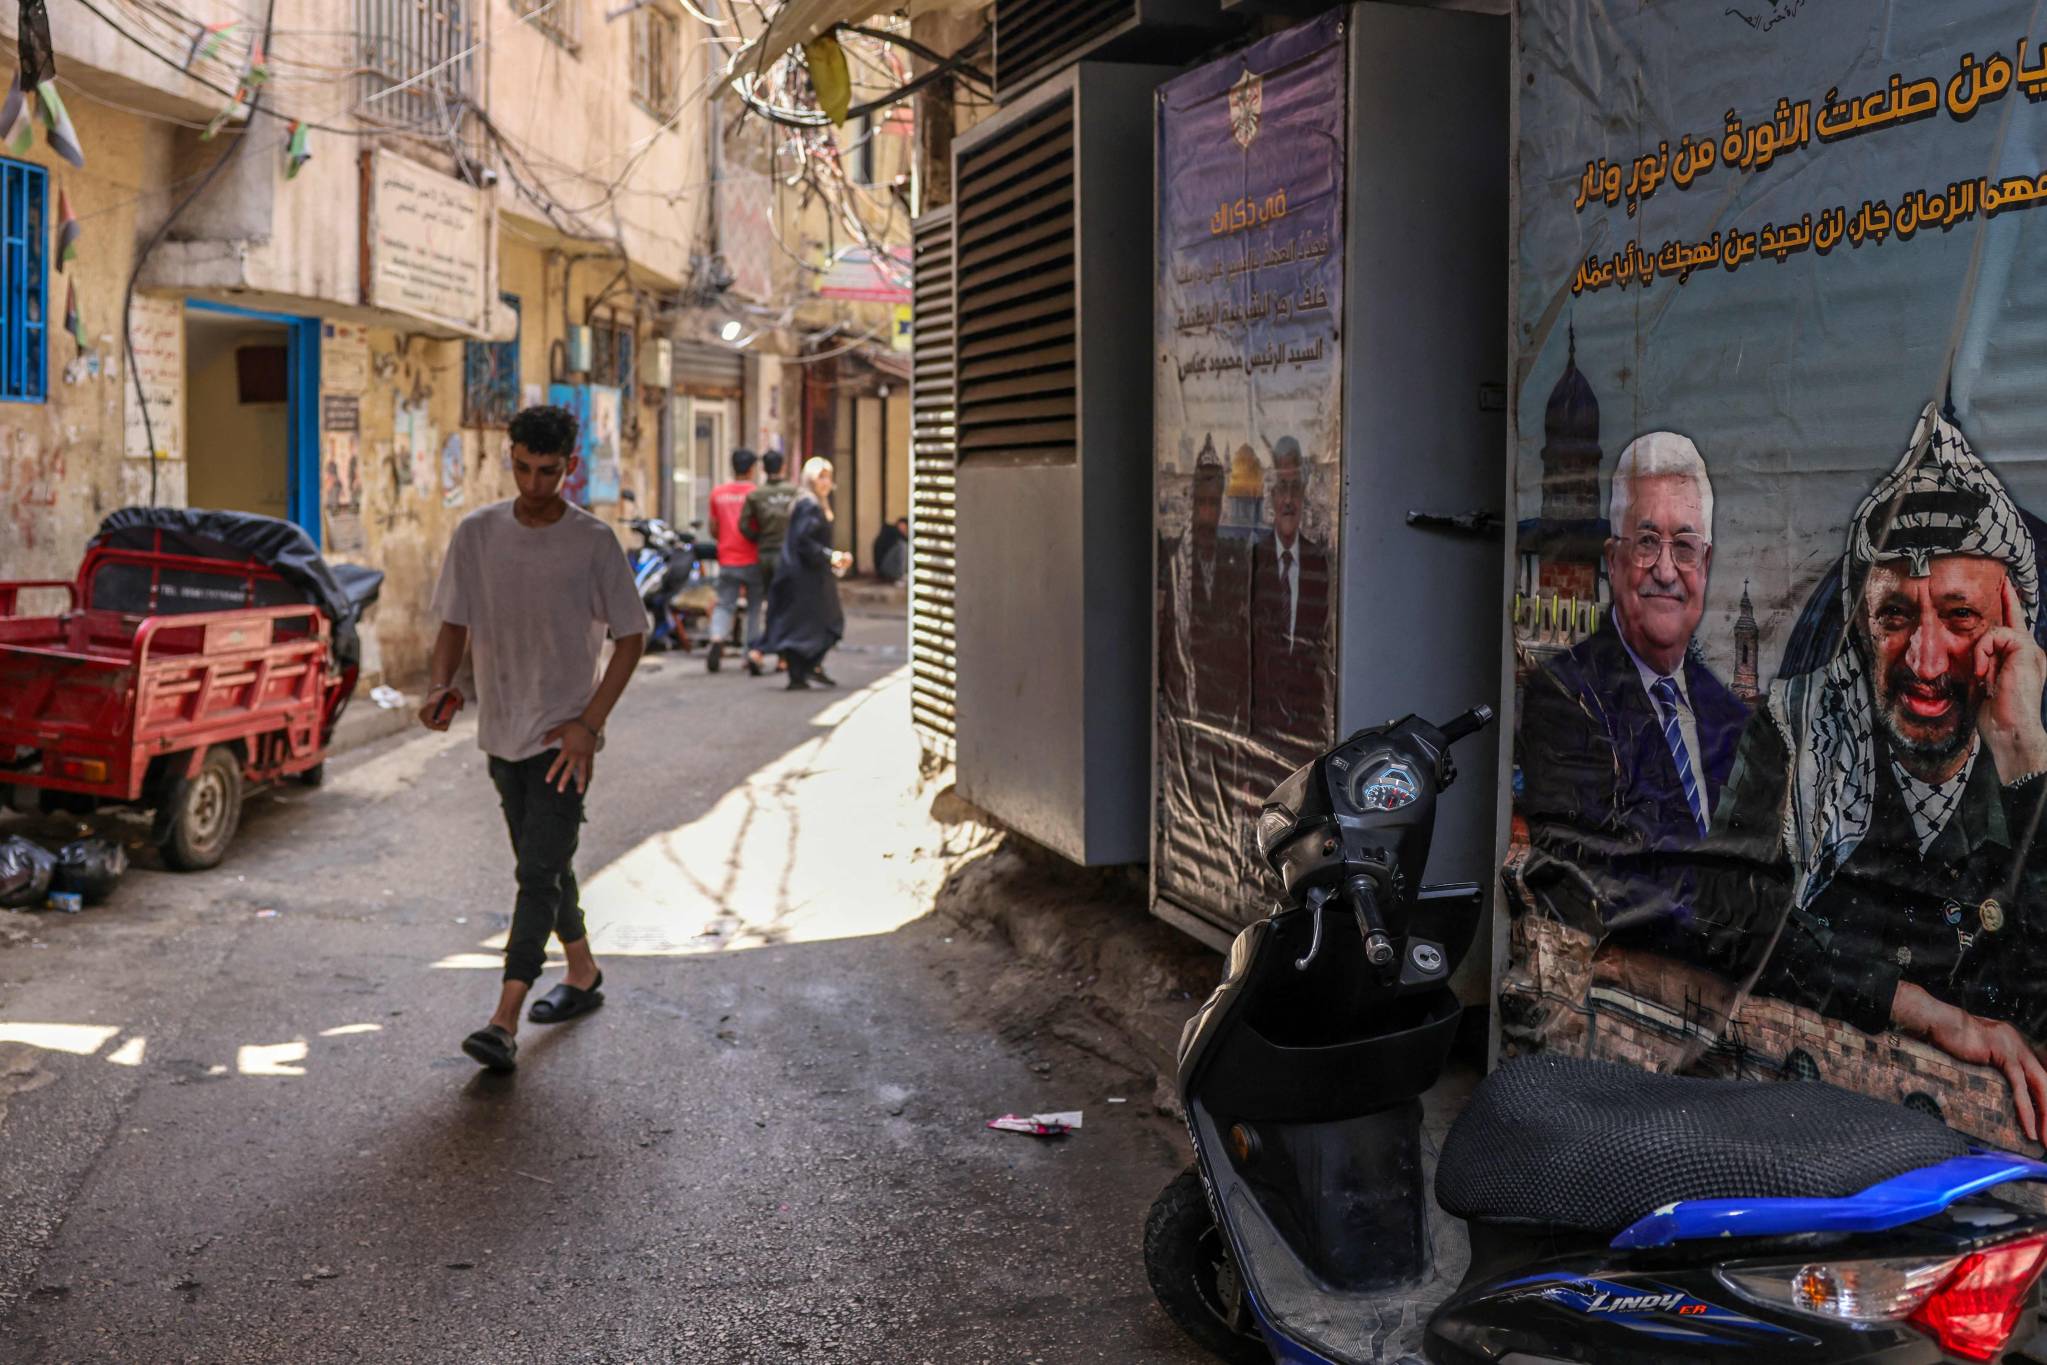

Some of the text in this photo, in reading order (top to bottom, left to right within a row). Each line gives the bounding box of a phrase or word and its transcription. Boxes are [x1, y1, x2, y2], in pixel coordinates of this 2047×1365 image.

[1671, 133, 1717, 190] من
[1210, 188, 1288, 236] في ذكراك
[1814, 206, 1846, 256] لن
[1894, 179, 1977, 241] الزمان
[1722, 227, 1757, 272] عن
[1287, 336, 1323, 371] السيد
[1586, 1291, 1686, 1313] LINDY
